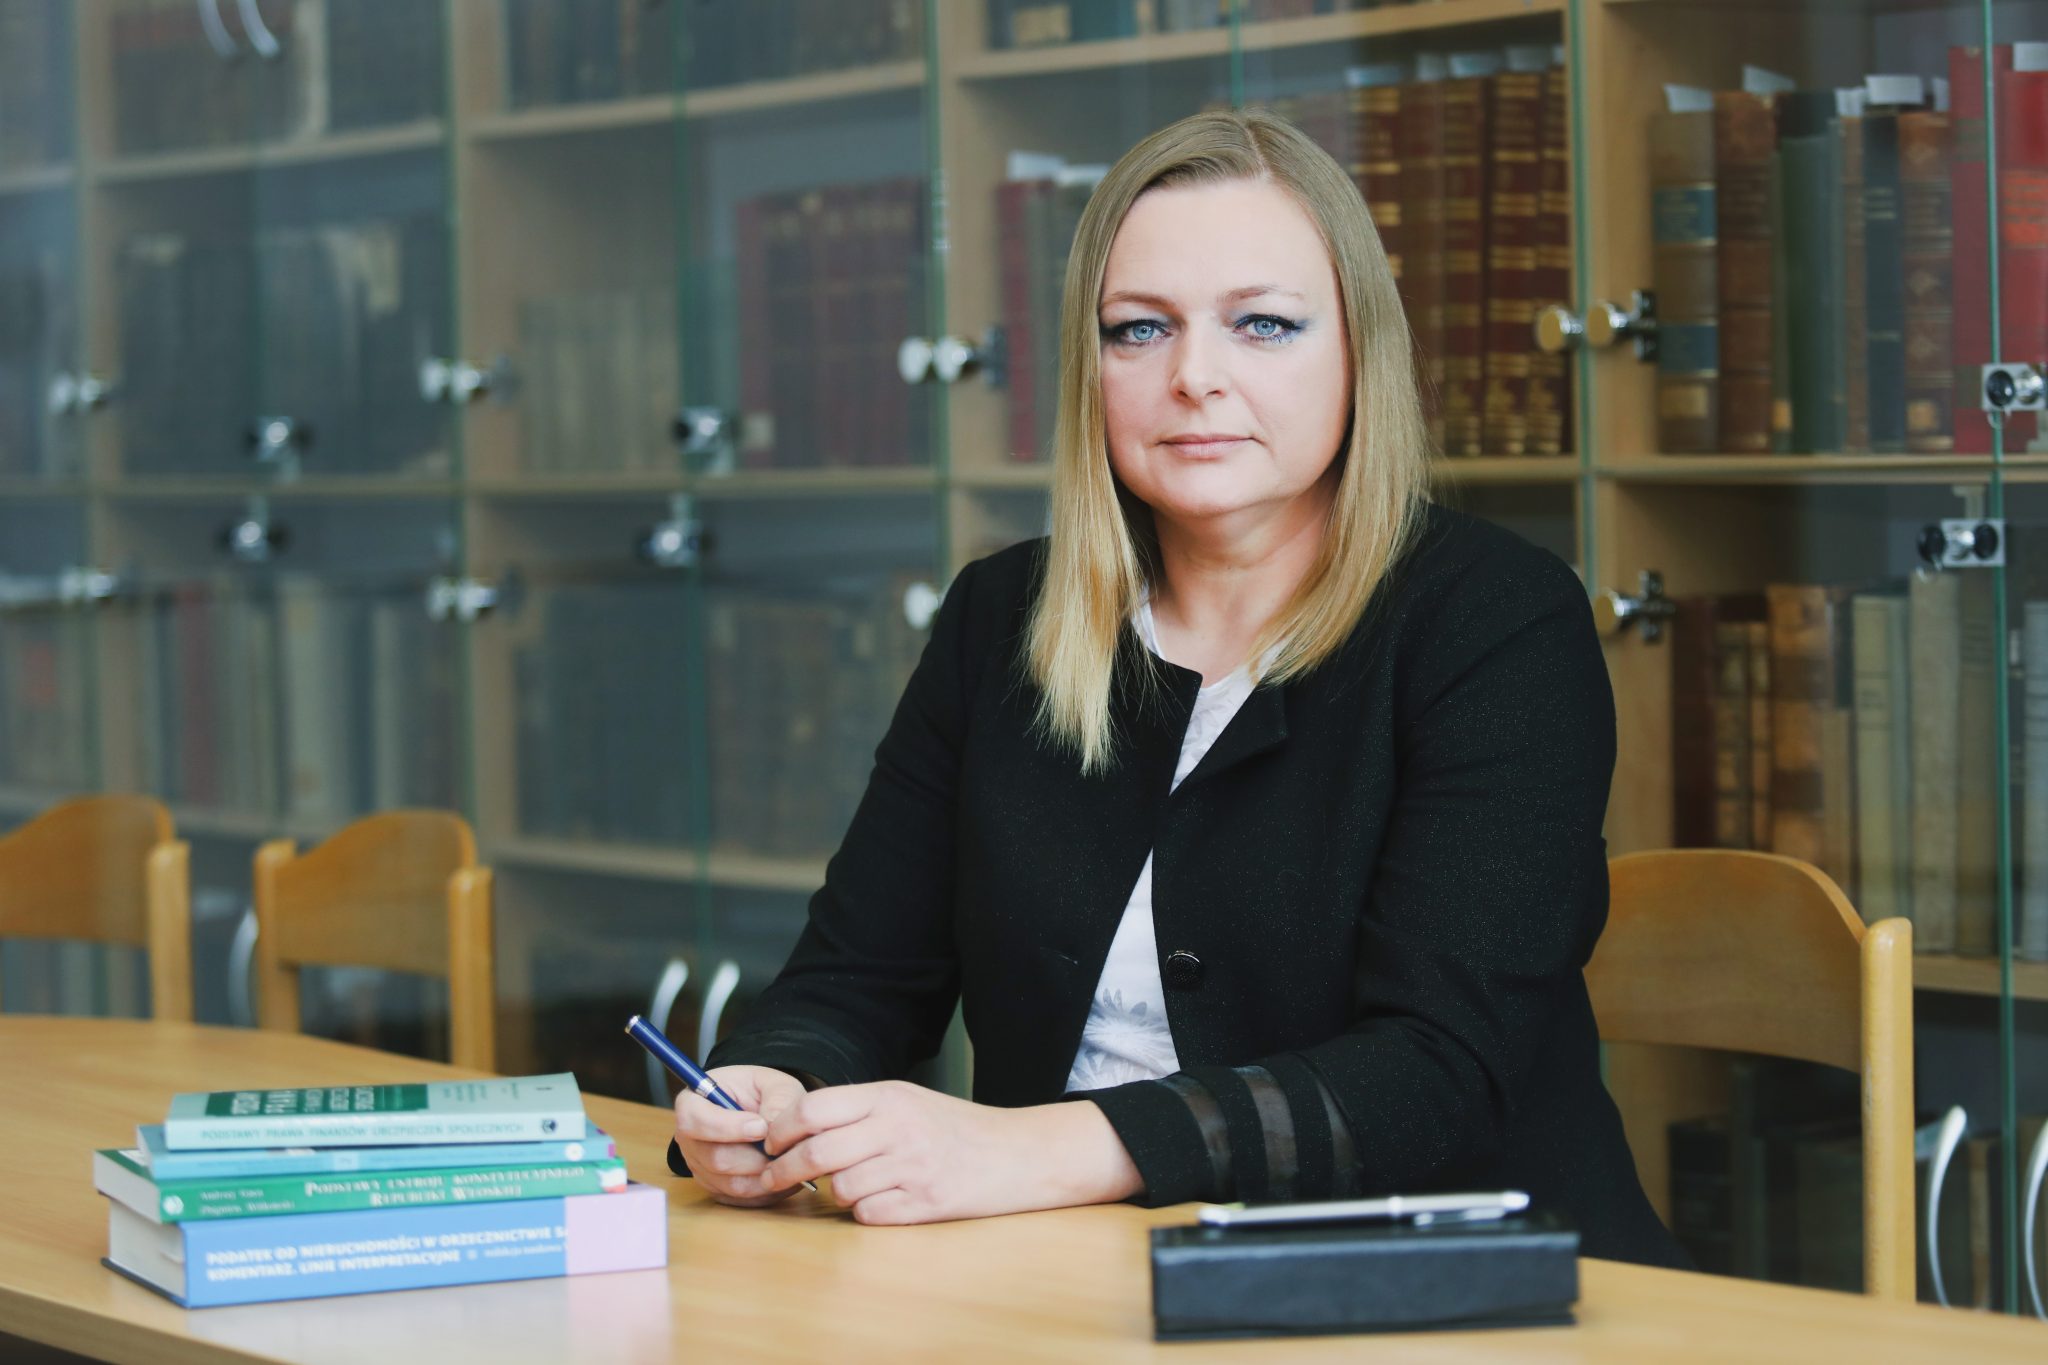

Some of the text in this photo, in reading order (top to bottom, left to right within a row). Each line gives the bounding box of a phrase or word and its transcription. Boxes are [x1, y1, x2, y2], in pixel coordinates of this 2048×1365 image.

[202, 1128, 261, 1140] PODSTAWY
[266, 1127, 304, 1138] PRAWA
[310, 1125, 367, 1137] FINANSÓW
[206, 1248, 273, 1265] PODATEK
[274, 1246, 298, 1261] OD
[301, 1235, 421, 1258] NIERUCHOMOŚCI
[422, 1235, 438, 1248] W
[439, 1226, 552, 1247] ORZECZNICTWIE
[206, 1263, 297, 1282] KOMENTARZ.
[300, 1260, 336, 1275] LINIE
[338, 1249, 461, 1271] INTERPRETACYJNE
